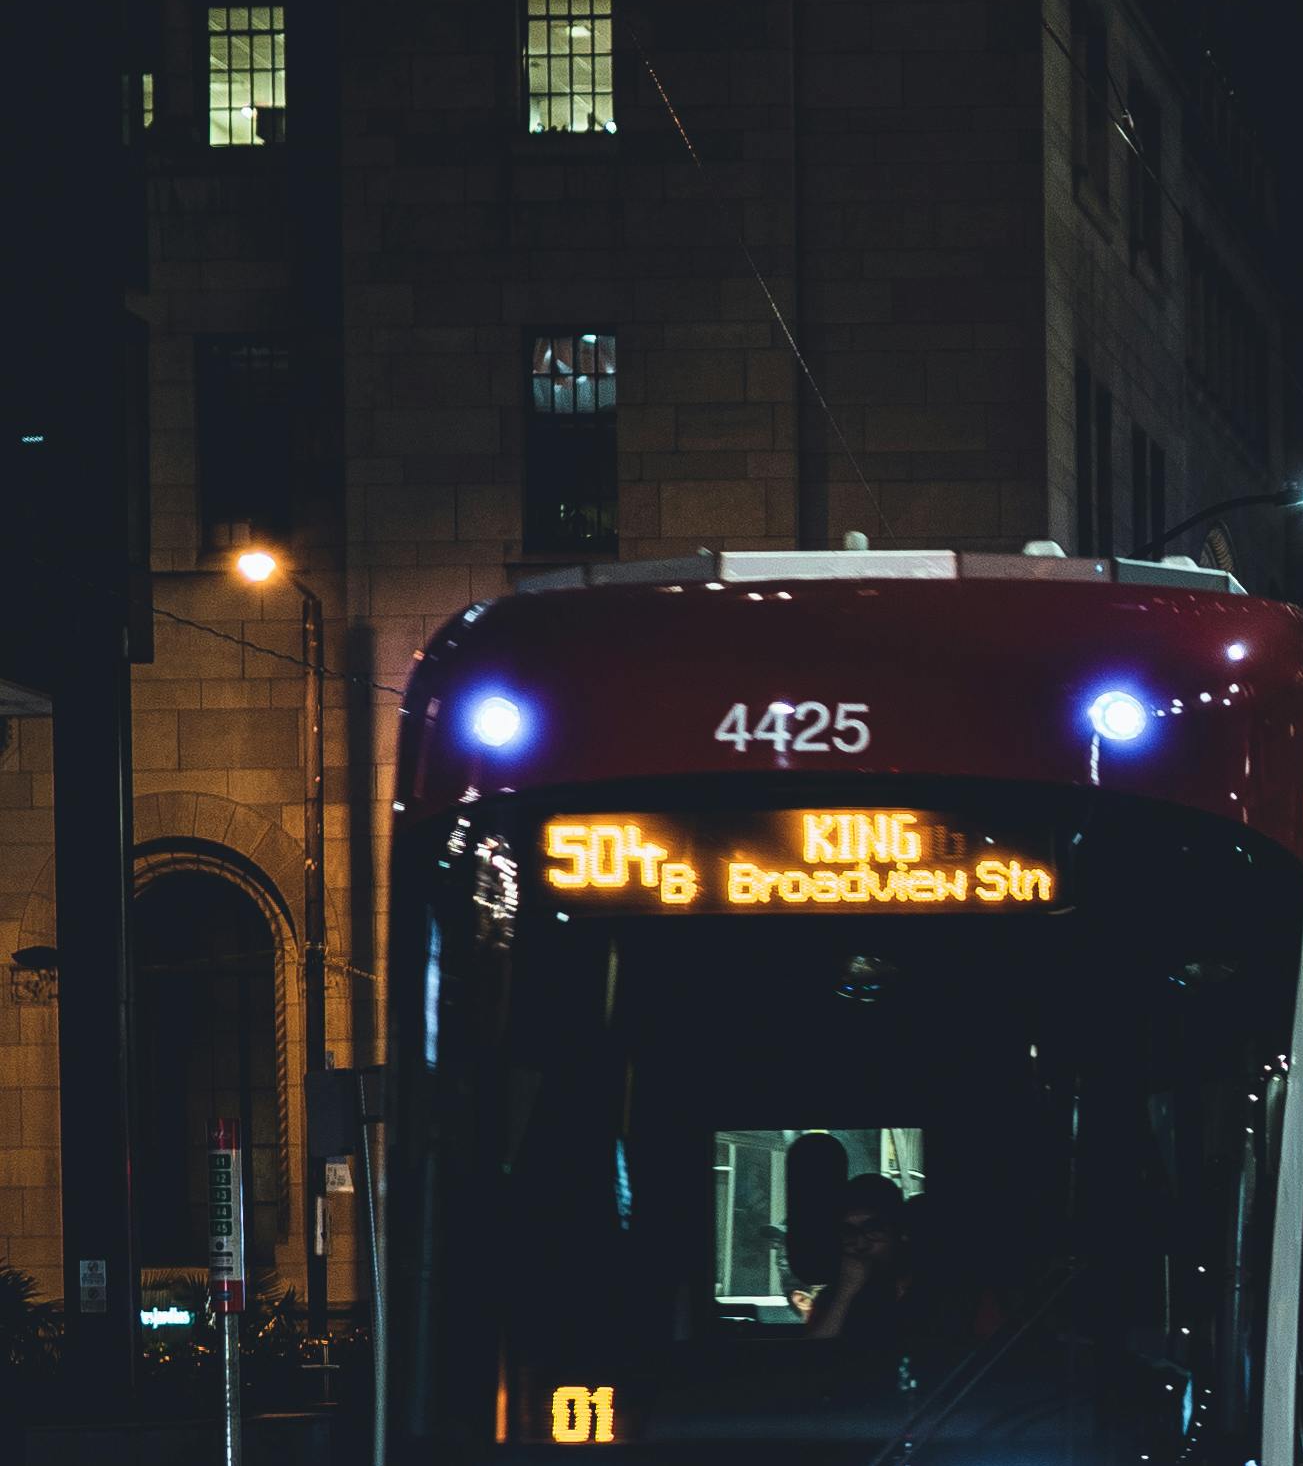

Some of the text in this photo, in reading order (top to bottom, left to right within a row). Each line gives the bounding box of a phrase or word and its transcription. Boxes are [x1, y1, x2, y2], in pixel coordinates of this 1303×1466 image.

[715, 702, 870, 753] 4425
[803, 813, 922, 863] KING
[727, 859, 1052, 904] Broadview Stn
[552, 1386, 614, 1442] 01
